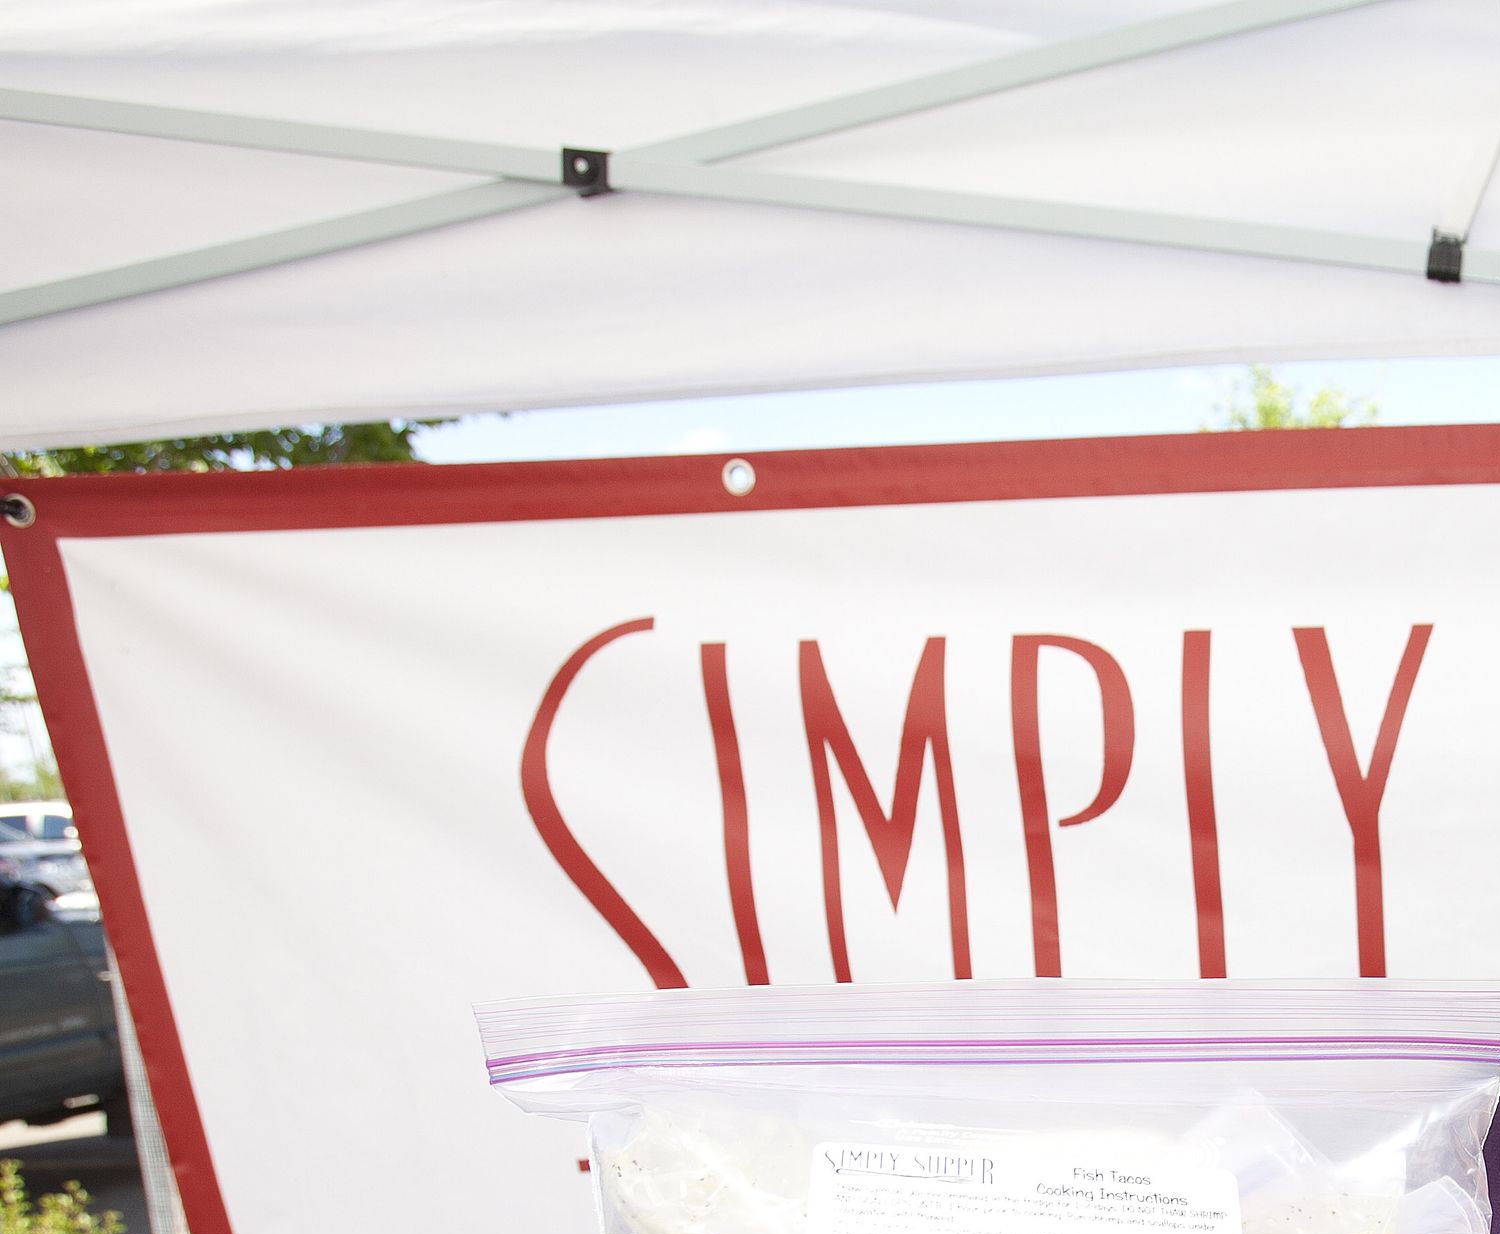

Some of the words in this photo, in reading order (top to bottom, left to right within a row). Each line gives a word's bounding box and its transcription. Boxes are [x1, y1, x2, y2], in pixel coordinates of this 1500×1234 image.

[521, 617, 1433, 988] SIMPLY
[825, 1149, 900, 1172] SIMPLY
[1073, 1167, 1104, 1182] Fish
[1109, 1170, 1152, 1185] Tacos
[1036, 1183, 1094, 1202] Cooking
[1100, 1187, 1189, 1206] Instructions
